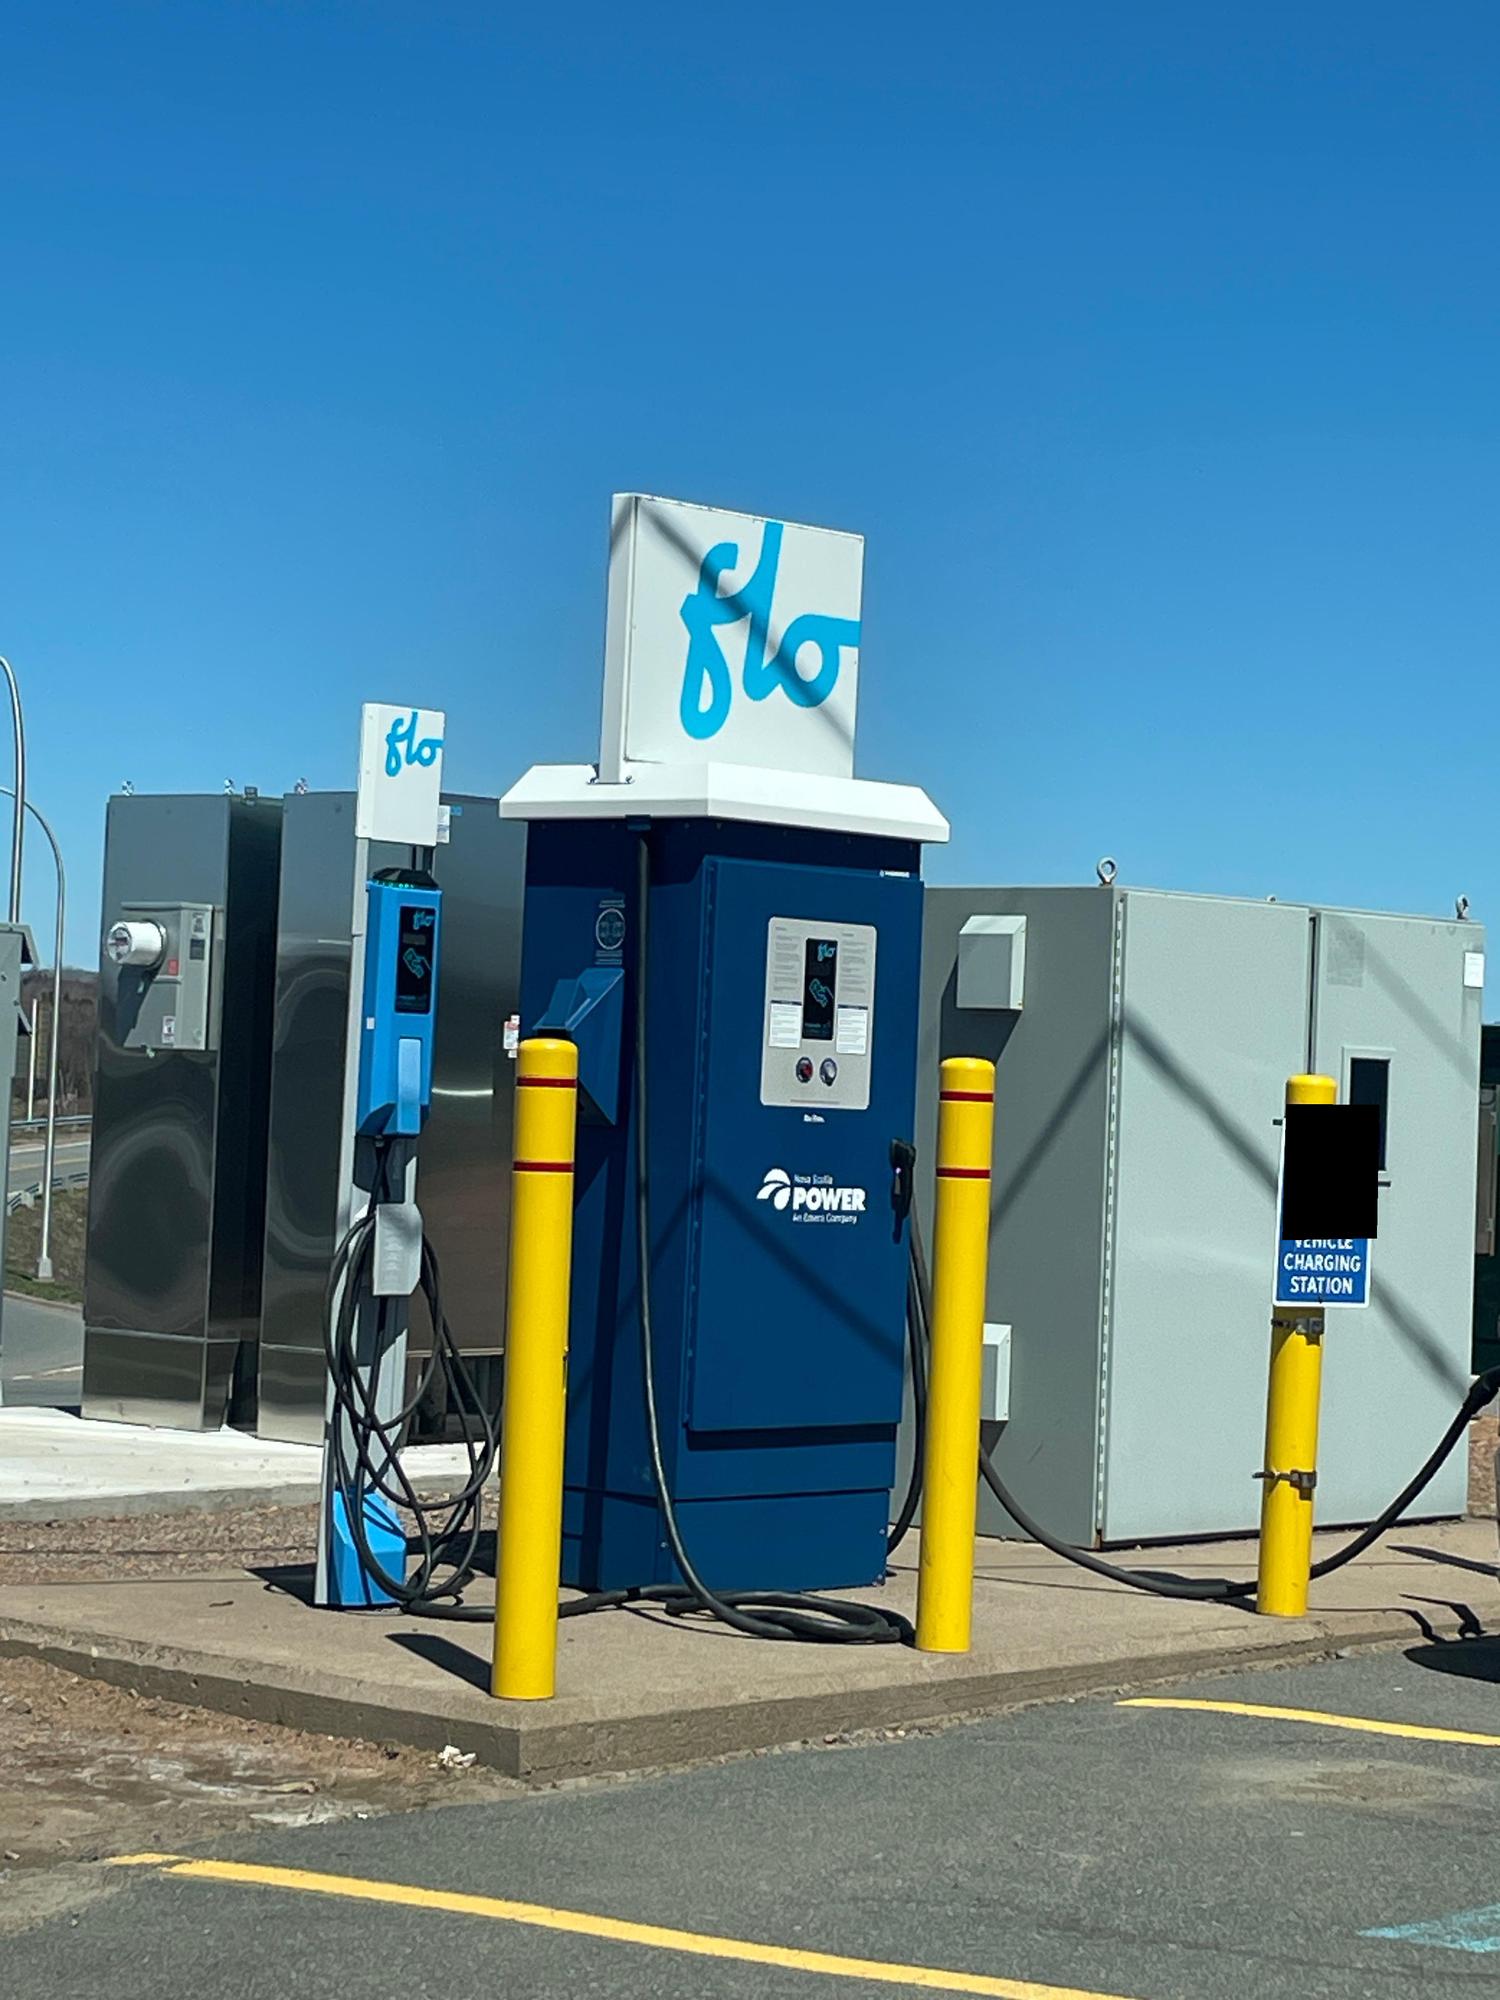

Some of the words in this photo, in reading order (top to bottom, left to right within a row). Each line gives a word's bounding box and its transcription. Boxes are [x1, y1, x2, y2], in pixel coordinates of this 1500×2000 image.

[679, 520, 861, 740] flo
[385, 711, 443, 777] flo
[793, 1187, 866, 1211] POWER
[1283, 1252, 1361, 1273] CHARGING
[1289, 1275, 1353, 1295] STATION
